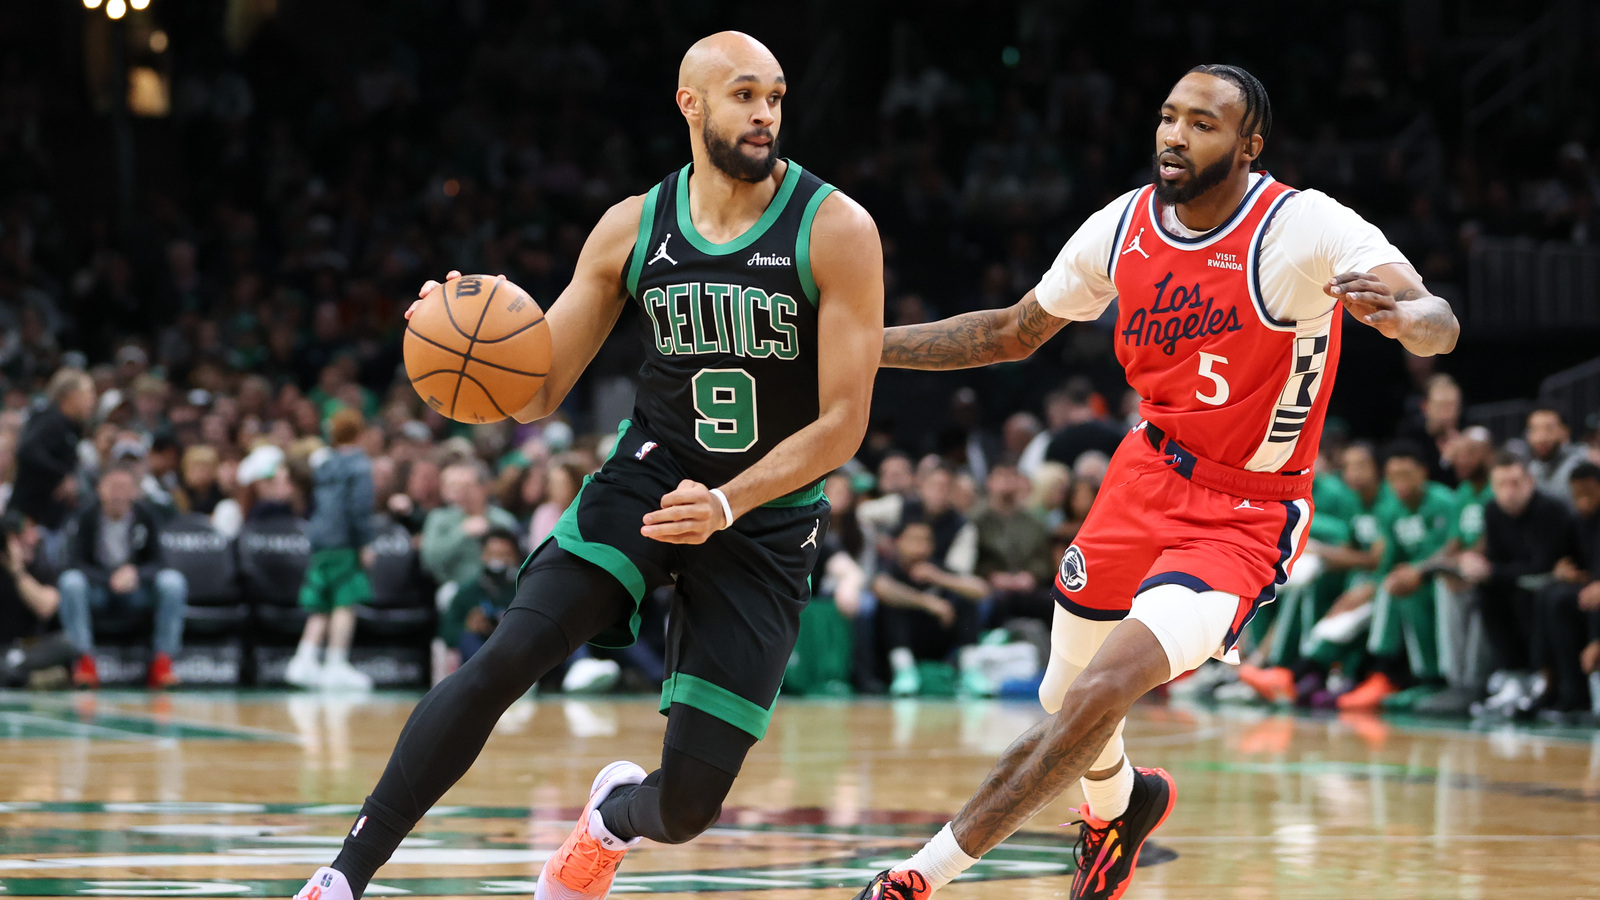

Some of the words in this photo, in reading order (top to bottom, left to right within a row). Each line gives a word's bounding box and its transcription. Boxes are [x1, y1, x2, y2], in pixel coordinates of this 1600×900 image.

[747, 252, 791, 266] Amica
[1207, 259, 1243, 271] RWANDA
[1216, 252, 1237, 262] VISIT
[1151, 272, 1203, 314] Los
[643, 282, 799, 360] CELTICS
[1123, 298, 1243, 356] Angeles
[1195, 352, 1230, 406] 5
[691, 368, 758, 452] 9
